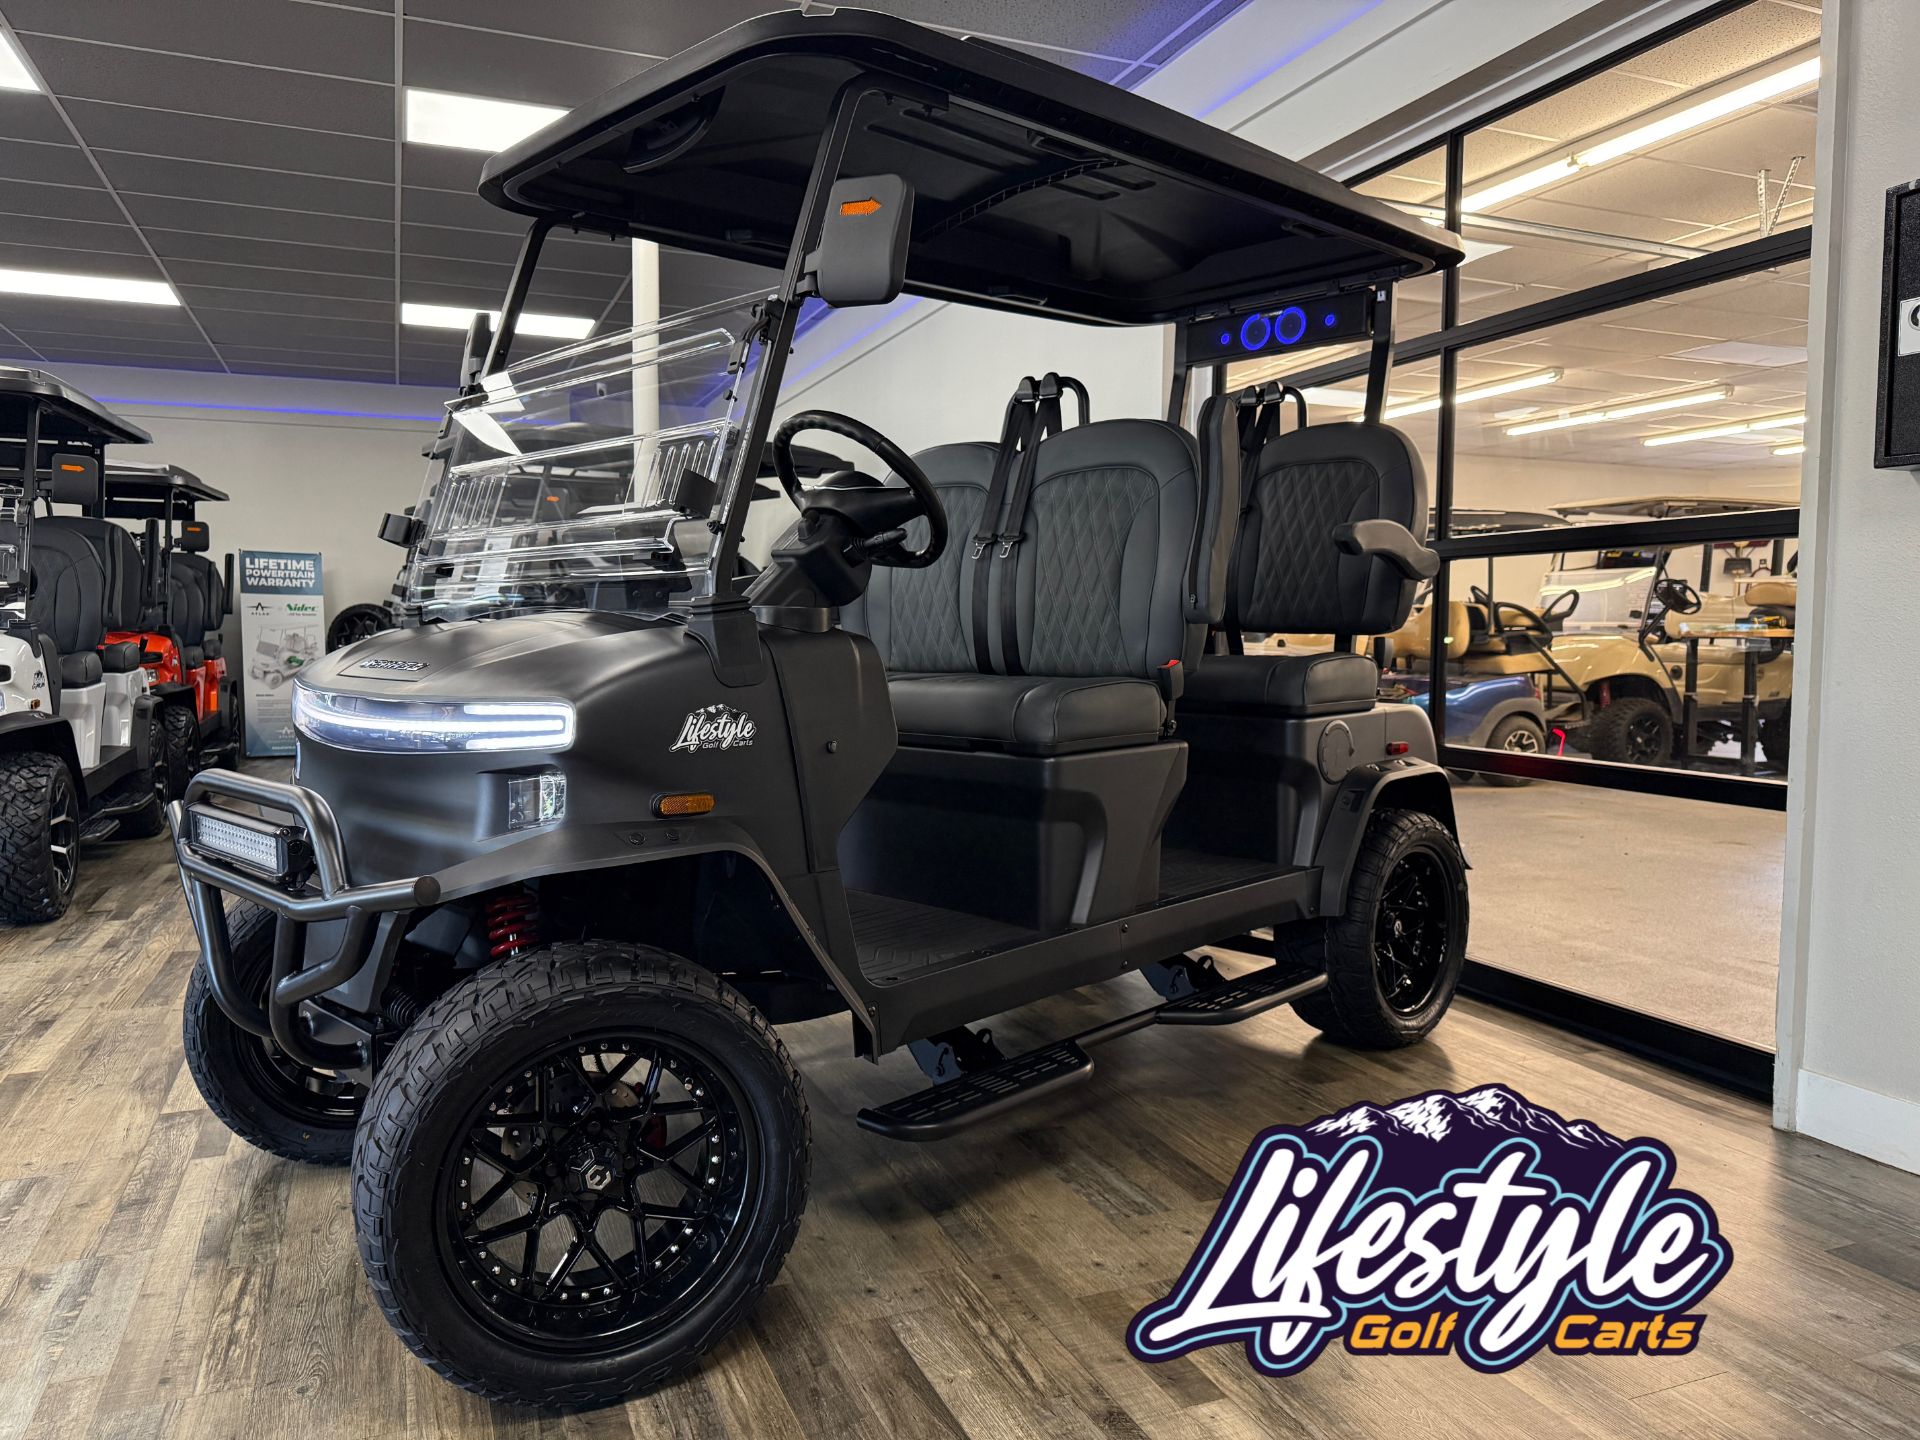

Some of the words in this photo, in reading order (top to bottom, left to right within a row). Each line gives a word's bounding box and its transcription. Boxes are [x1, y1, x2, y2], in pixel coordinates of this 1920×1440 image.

[245, 557, 314, 571] LIFETIME
[245, 568, 315, 579] POWERTRAIN
[246, 577, 316, 588] WARRANTY
[670, 713, 755, 751] Lifestyle
[733, 739, 753, 747] Carts
